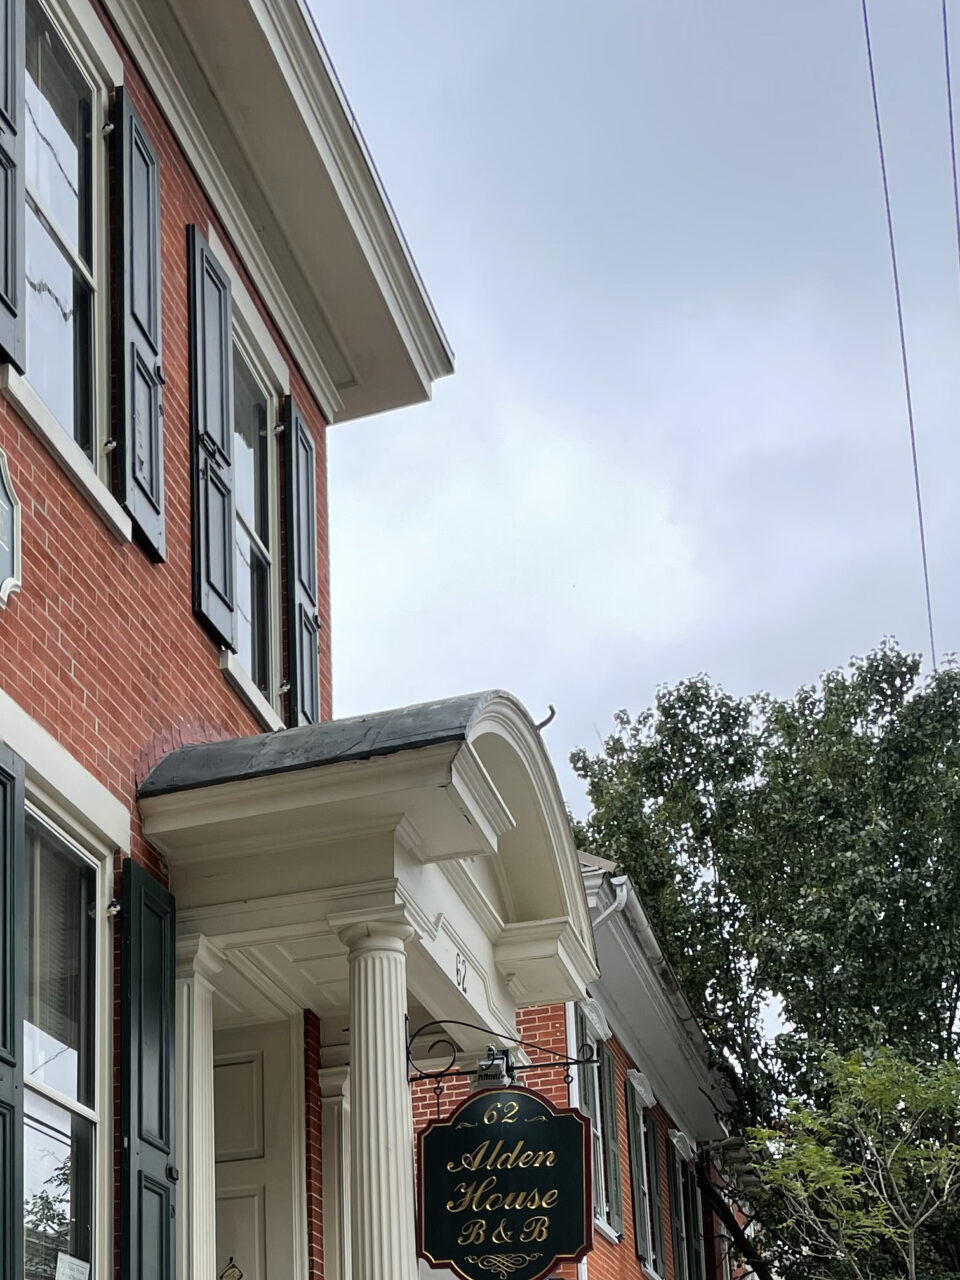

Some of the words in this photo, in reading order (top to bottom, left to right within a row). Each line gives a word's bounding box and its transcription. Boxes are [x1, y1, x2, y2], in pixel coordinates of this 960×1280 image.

[455, 952, 467, 995] 62
[483, 1101, 520, 1125] 62
[446, 1139, 557, 1173] Alden
[445, 1175, 559, 1213] House
